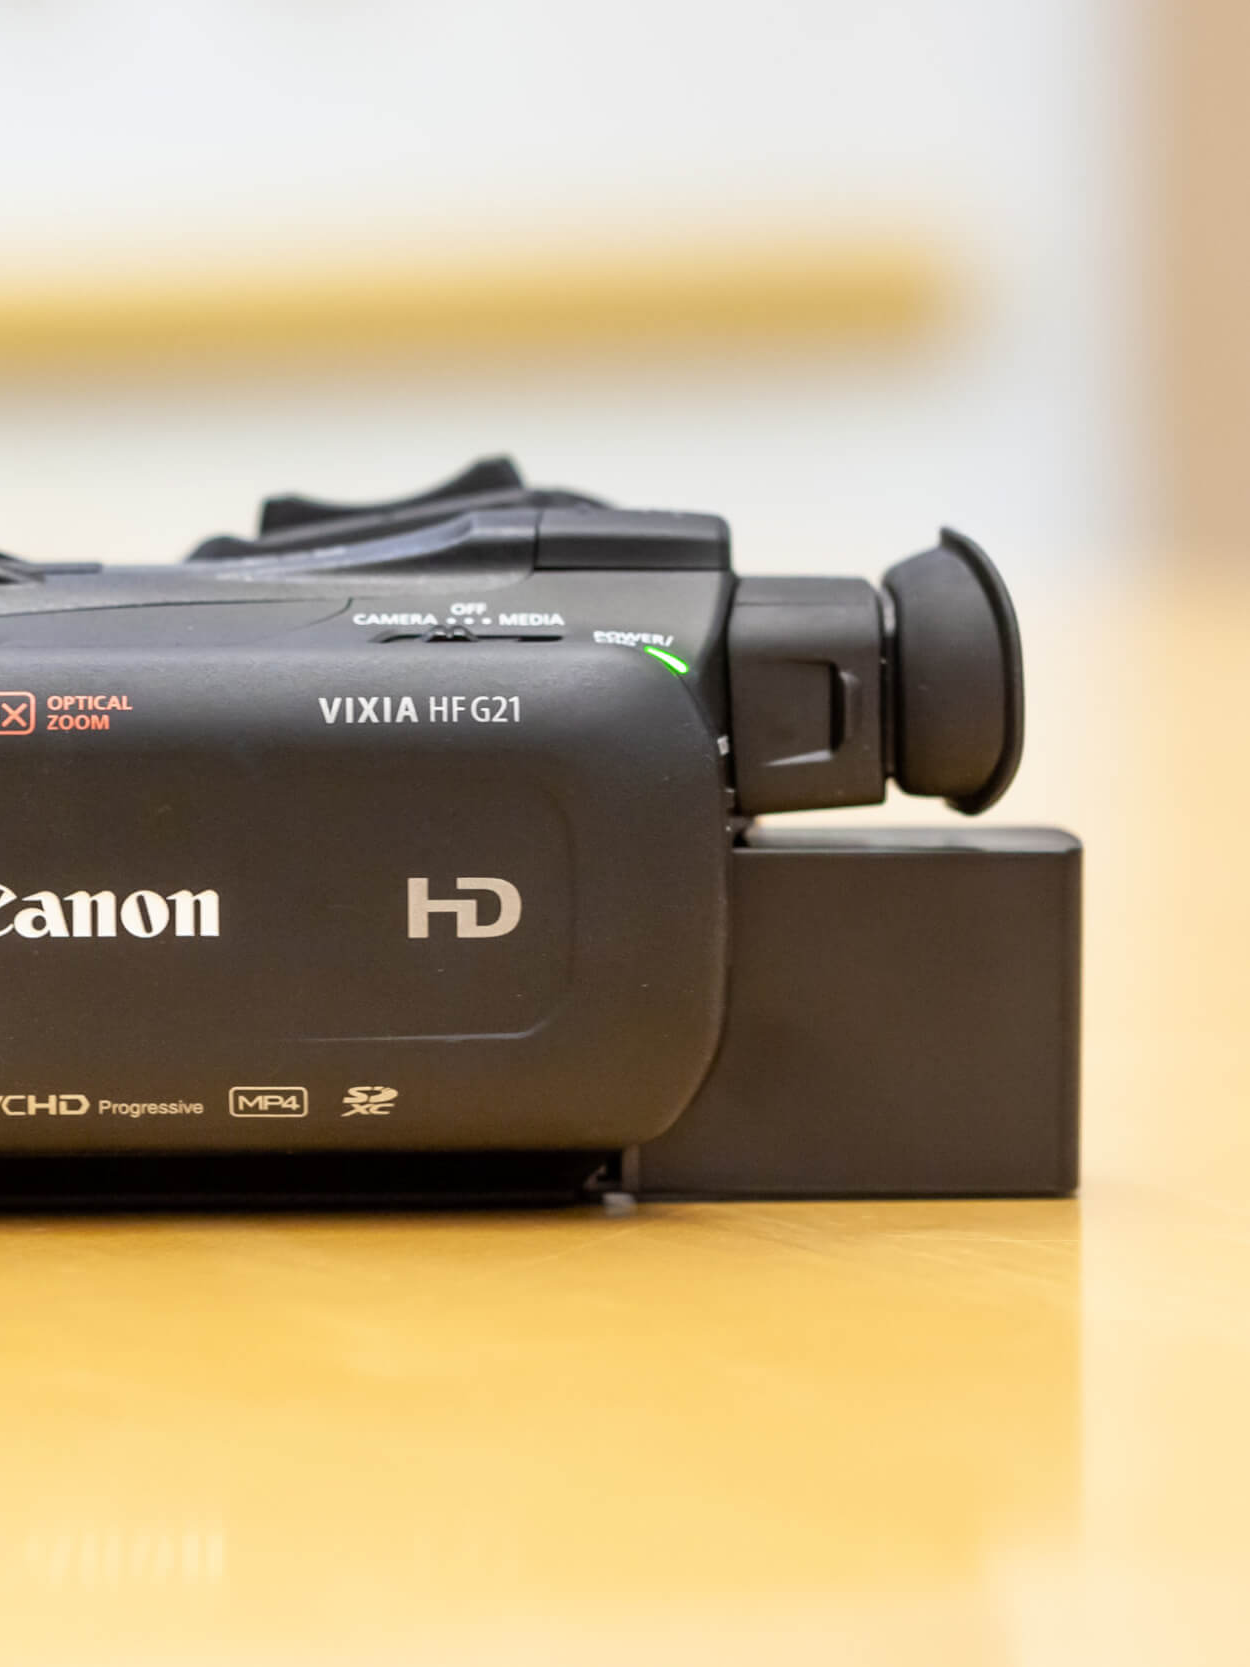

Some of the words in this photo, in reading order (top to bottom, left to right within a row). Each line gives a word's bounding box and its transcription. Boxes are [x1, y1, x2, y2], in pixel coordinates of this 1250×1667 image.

[450, 603, 487, 616] OFF
[352, 613, 439, 626] CAMERA
[498, 613, 565, 626] MEDIA
[46, 695, 133, 711] OPTICAL
[318, 697, 419, 724] VIXIA
[429, 696, 465, 723] HF
[470, 696, 521, 723] G21
[46, 714, 111, 731] ZOOM
[407, 877, 522, 939] HD
[98, 1099, 204, 1119] Progressive
[237, 1095, 301, 1111] MP4
